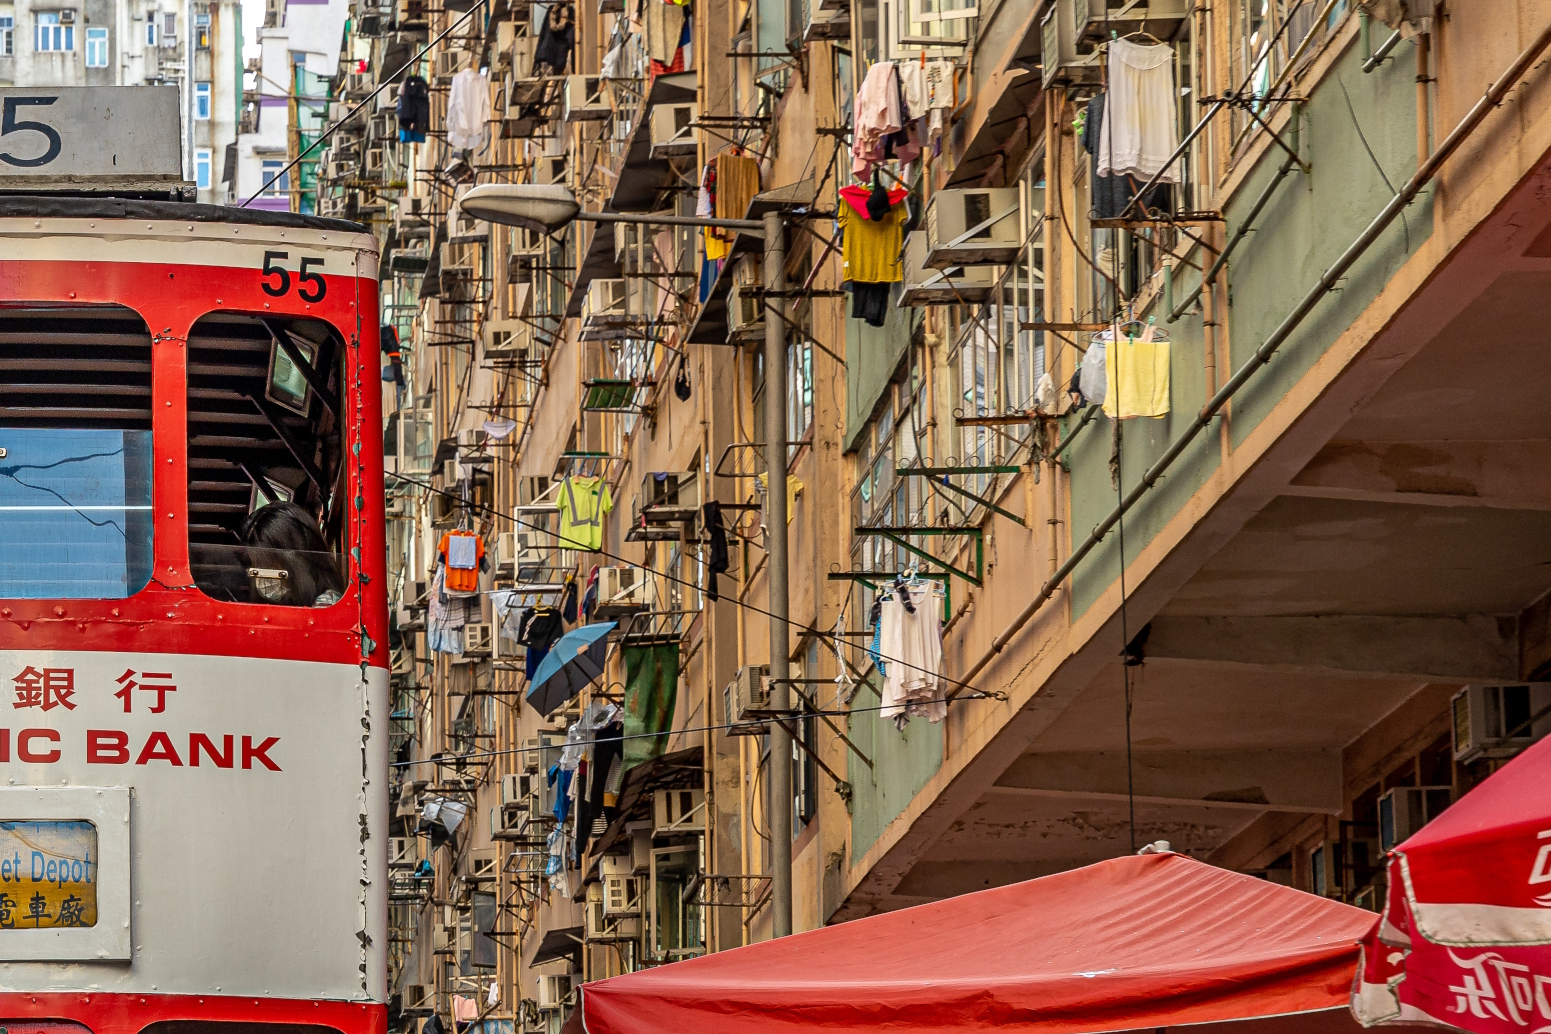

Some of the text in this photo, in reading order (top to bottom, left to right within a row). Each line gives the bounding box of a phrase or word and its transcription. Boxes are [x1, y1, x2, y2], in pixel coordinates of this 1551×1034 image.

[260, 250, 327, 304] 55
[86, 730, 283, 772] BANK
[30, 850, 92, 888] Depot
